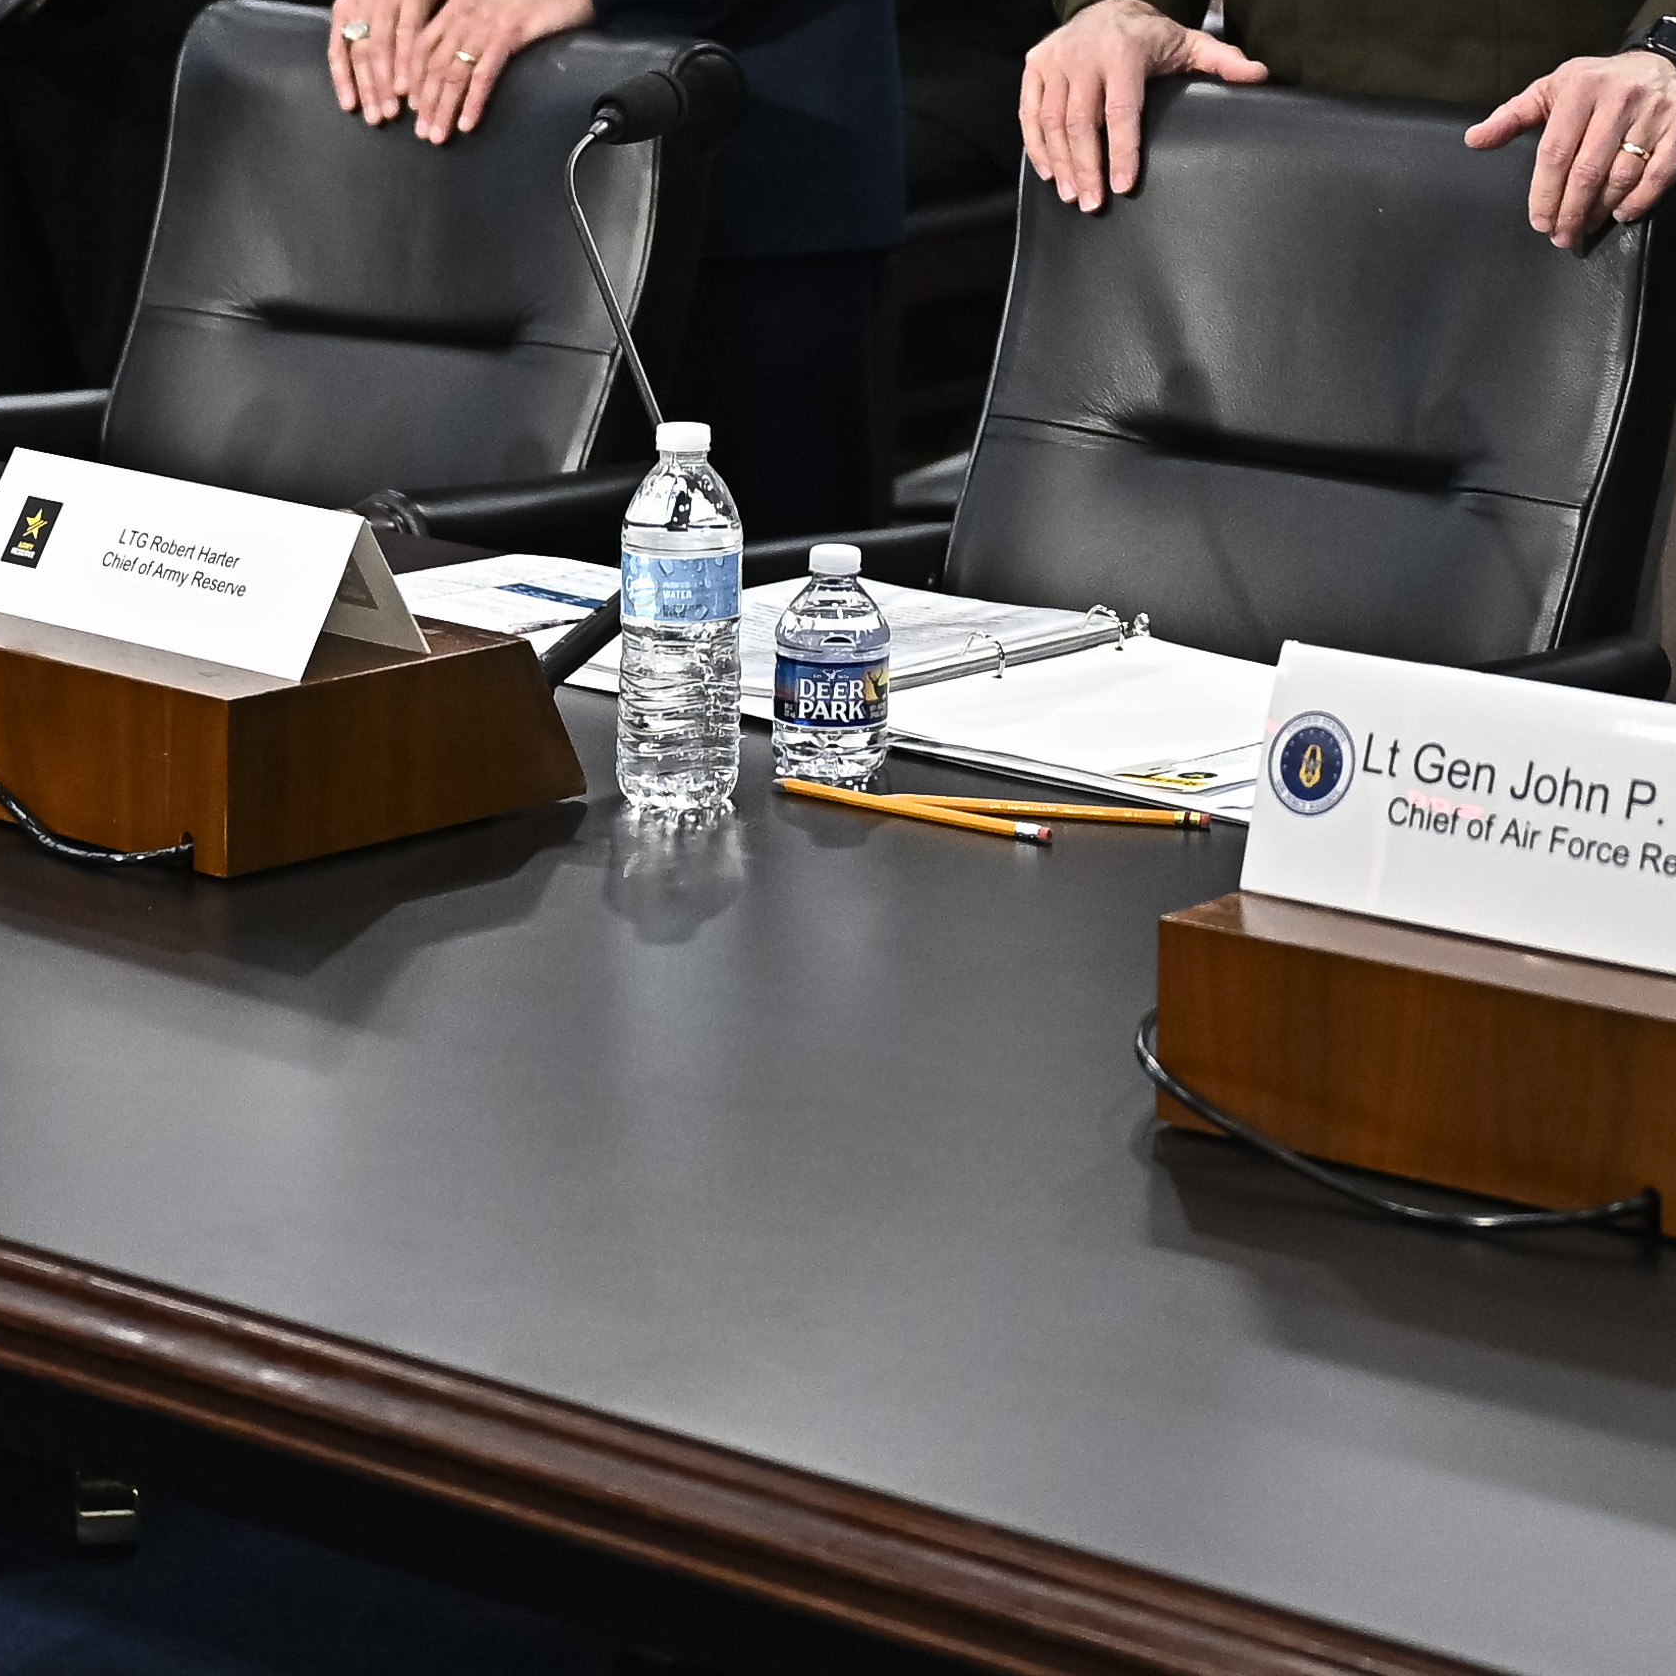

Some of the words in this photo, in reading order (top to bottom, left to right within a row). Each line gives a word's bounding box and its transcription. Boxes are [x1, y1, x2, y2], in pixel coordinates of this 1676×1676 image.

[118, 528, 150, 549] LTG
[149, 535, 197, 560] Robert
[197, 545, 241, 569] Harter
[102, 551, 139, 572] Chief
[138, 560, 155, 576] of
[152, 563, 190, 588] Army
[190, 570, 247, 598] Reserve
[662, 589, 693, 600] WATER
[799, 677, 865, 700] DEER
[797, 698, 866, 724] PARK
[1362, 732, 1401, 778] Lt
[1412, 742, 1496, 795] Gen
[1509, 759, 1610, 815] John
[1624, 778, 1665, 826] P.
[1386, 795, 1462, 836] Chief
[1465, 812, 1498, 843] of
[1498, 818, 1542, 851] Air
[1547, 824, 1630, 868] Force
